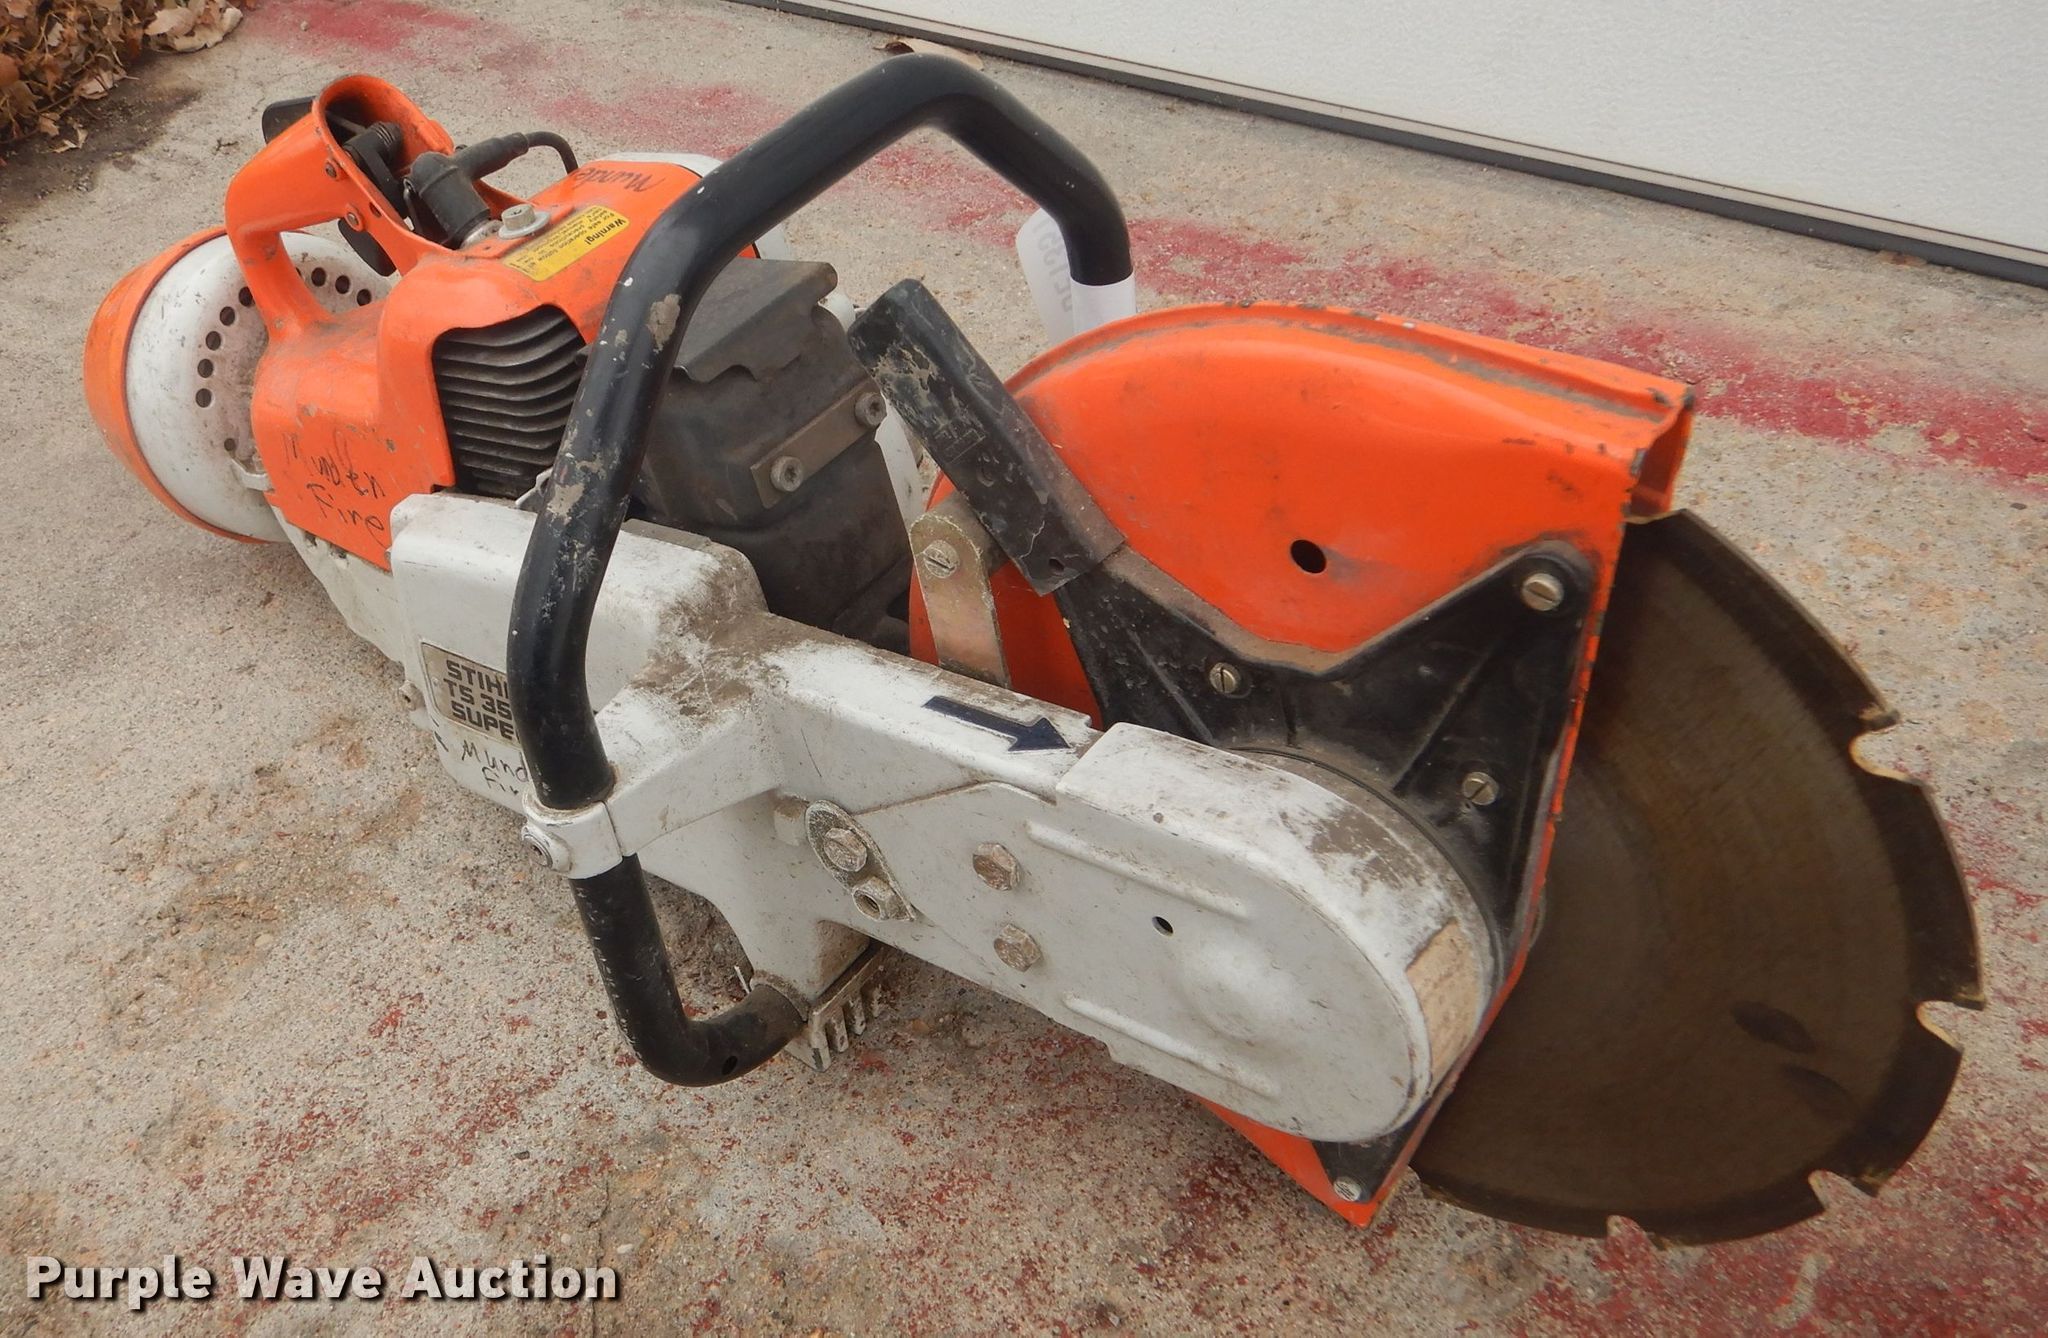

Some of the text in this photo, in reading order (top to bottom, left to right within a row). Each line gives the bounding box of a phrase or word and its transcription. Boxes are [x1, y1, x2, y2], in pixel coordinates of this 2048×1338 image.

[584, 217, 626, 246] Warning!
[443, 677, 513, 721] TS 35
[450, 699, 518, 742] SUPE
